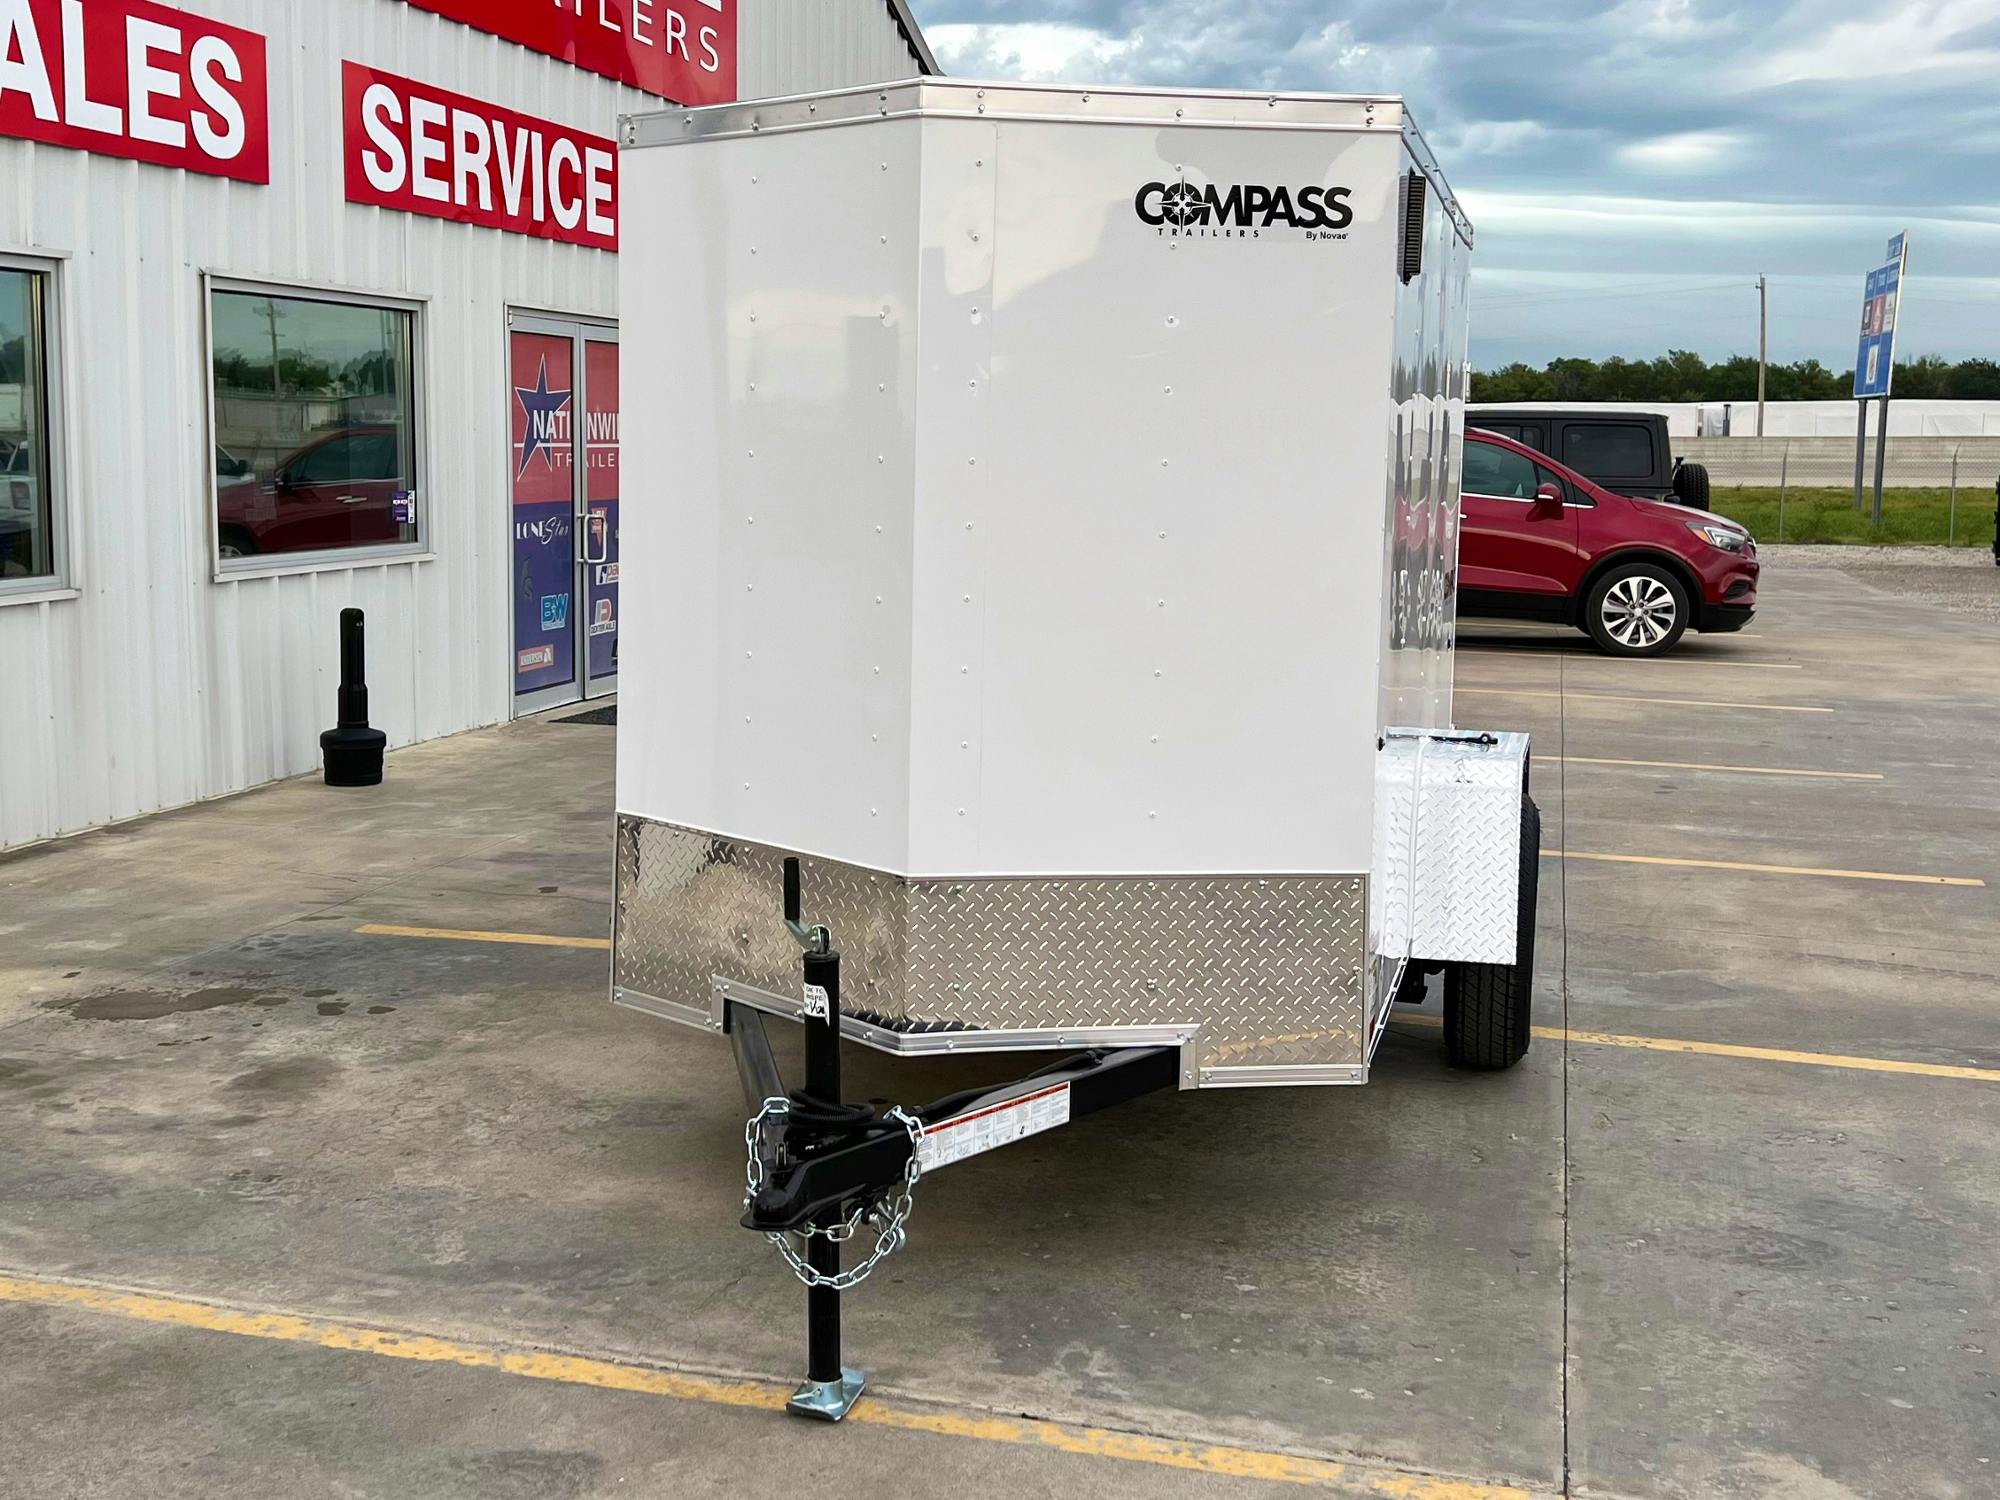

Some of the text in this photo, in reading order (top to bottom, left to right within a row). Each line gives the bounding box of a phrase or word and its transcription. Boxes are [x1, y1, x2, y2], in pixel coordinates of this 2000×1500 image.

[361, 83, 615, 237] SERVICE
[1134, 180, 1354, 229] COMPASS
[1157, 227, 1260, 238] TRAILERS
[1305, 231, 1317, 241] By
